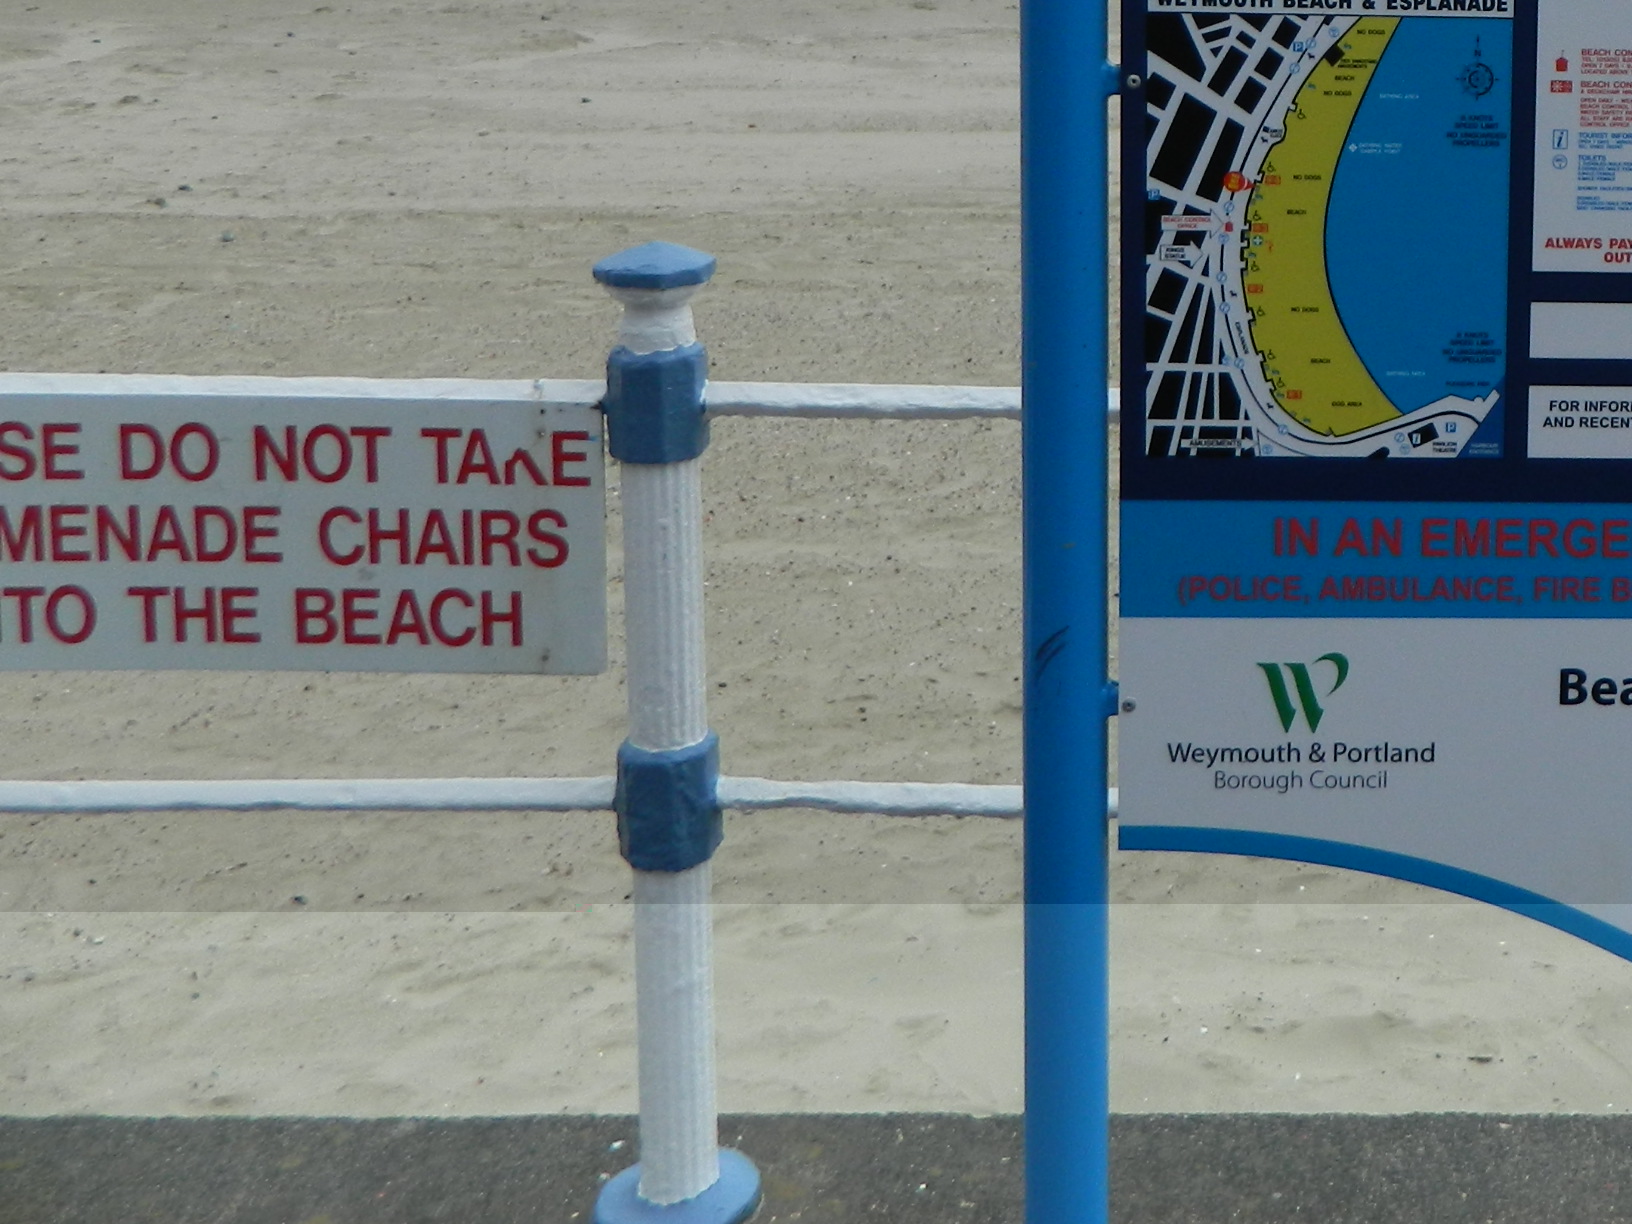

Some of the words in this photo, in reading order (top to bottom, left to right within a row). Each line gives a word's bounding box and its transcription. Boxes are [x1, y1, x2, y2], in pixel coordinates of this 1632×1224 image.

[1544, 237, 1602, 249] ALWAYS
[1603, 251, 1632, 263] OUT
[1549, 400, 1579, 412] FOR
[1542, 416, 1574, 428] AND
[0, 421, 84, 481] SE
[119, 421, 219, 482] DO
[253, 423, 392, 484] NOT
[0, 504, 283, 563] MENADE
[318, 505, 569, 569] CHAIRS
[1273, 516, 1318, 557] IN
[1333, 517, 1402, 557] AN
[1176, 573, 1309, 606] (POLICE,
[1317, 575, 1522, 605] AMBULANCE,
[1532, 575, 1600, 603] FIRE
[0, 584, 96, 644] TO
[126, 586, 261, 644] THE
[294, 587, 523, 648] BEACH
[1167, 741, 1300, 768] Weymouth
[1308, 742, 1325, 763] &
[1333, 741, 1434, 763] Portland
[1213, 768, 1303, 794] Borough
[1309, 769, 1387, 788] Council
